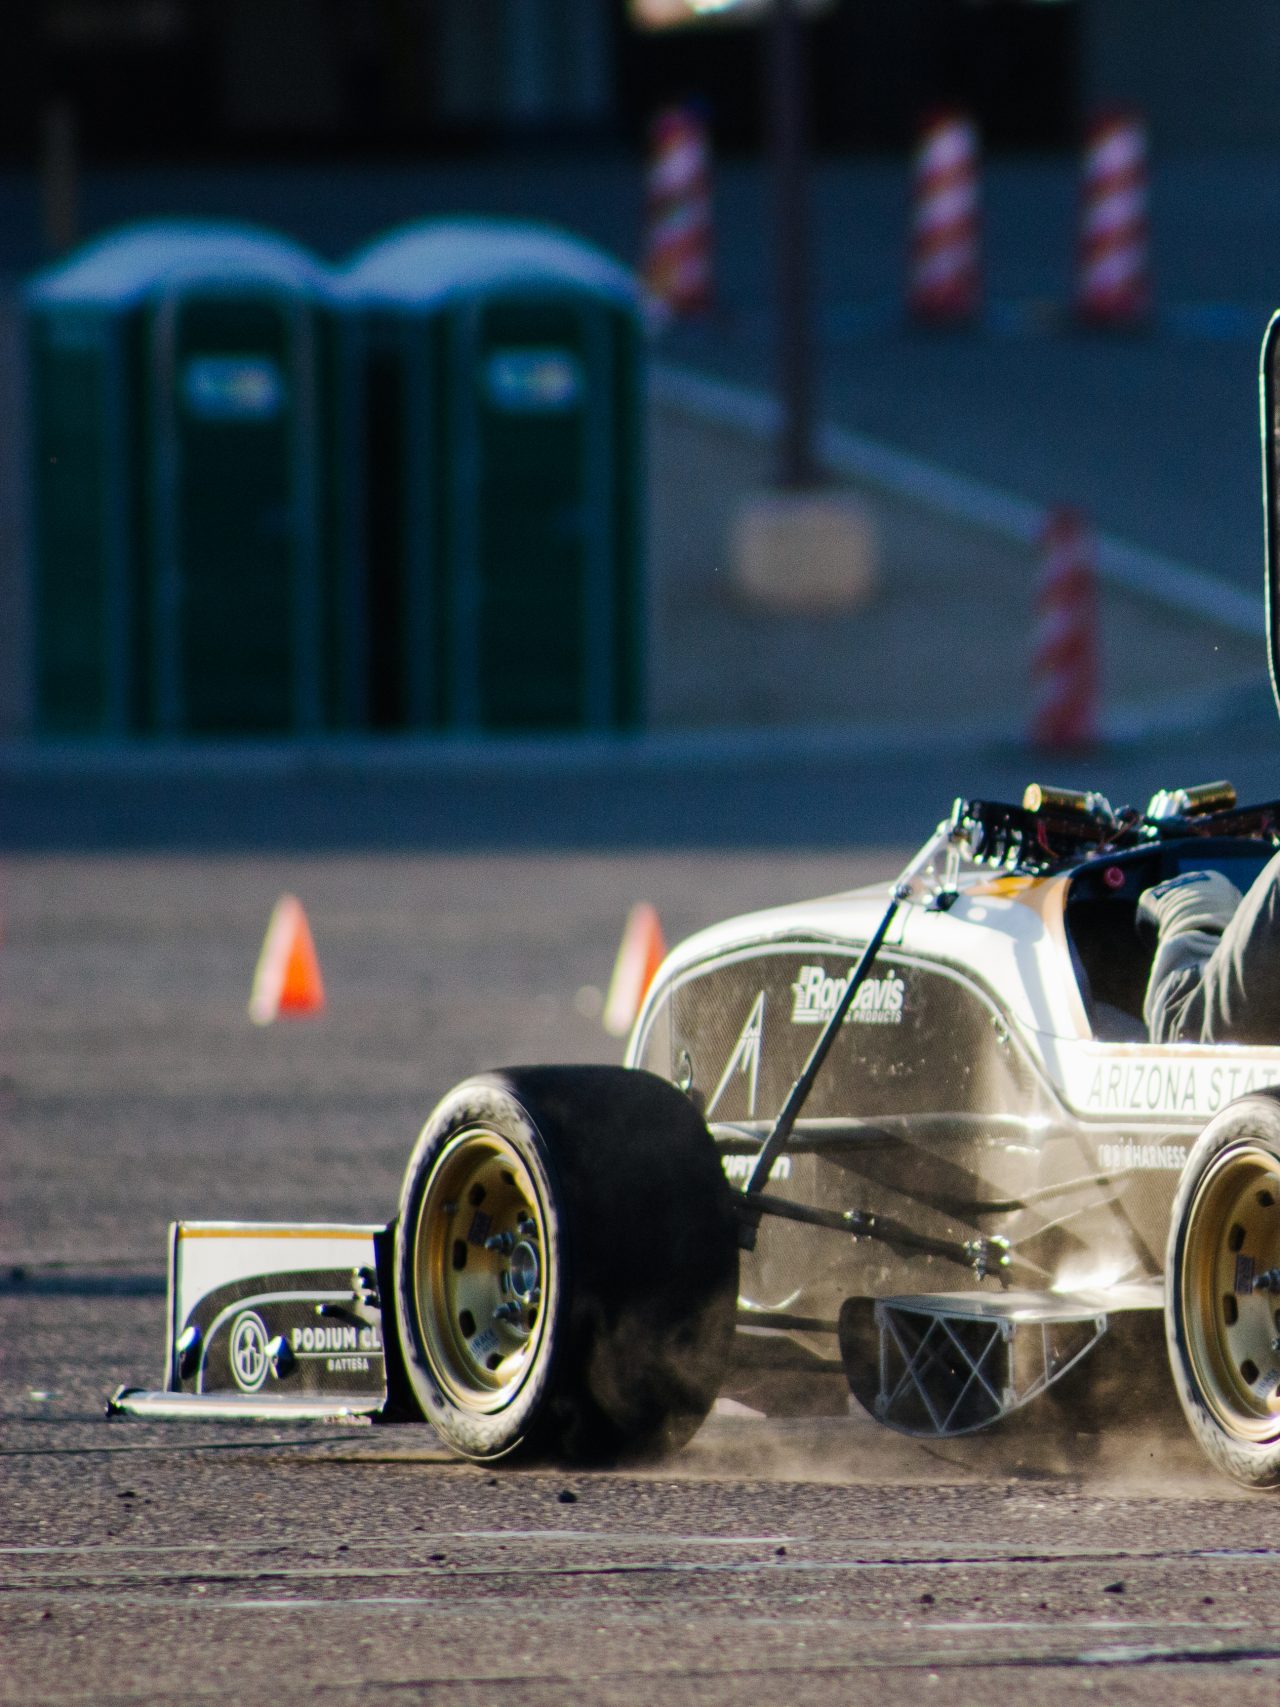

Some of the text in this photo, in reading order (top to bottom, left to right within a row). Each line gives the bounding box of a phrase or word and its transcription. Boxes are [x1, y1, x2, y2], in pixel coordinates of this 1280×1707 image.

[801, 965, 905, 1010] Ronavis
[1087, 1063, 1198, 1112] ARIZONA
[292, 1326, 358, 1352] PODIUM
